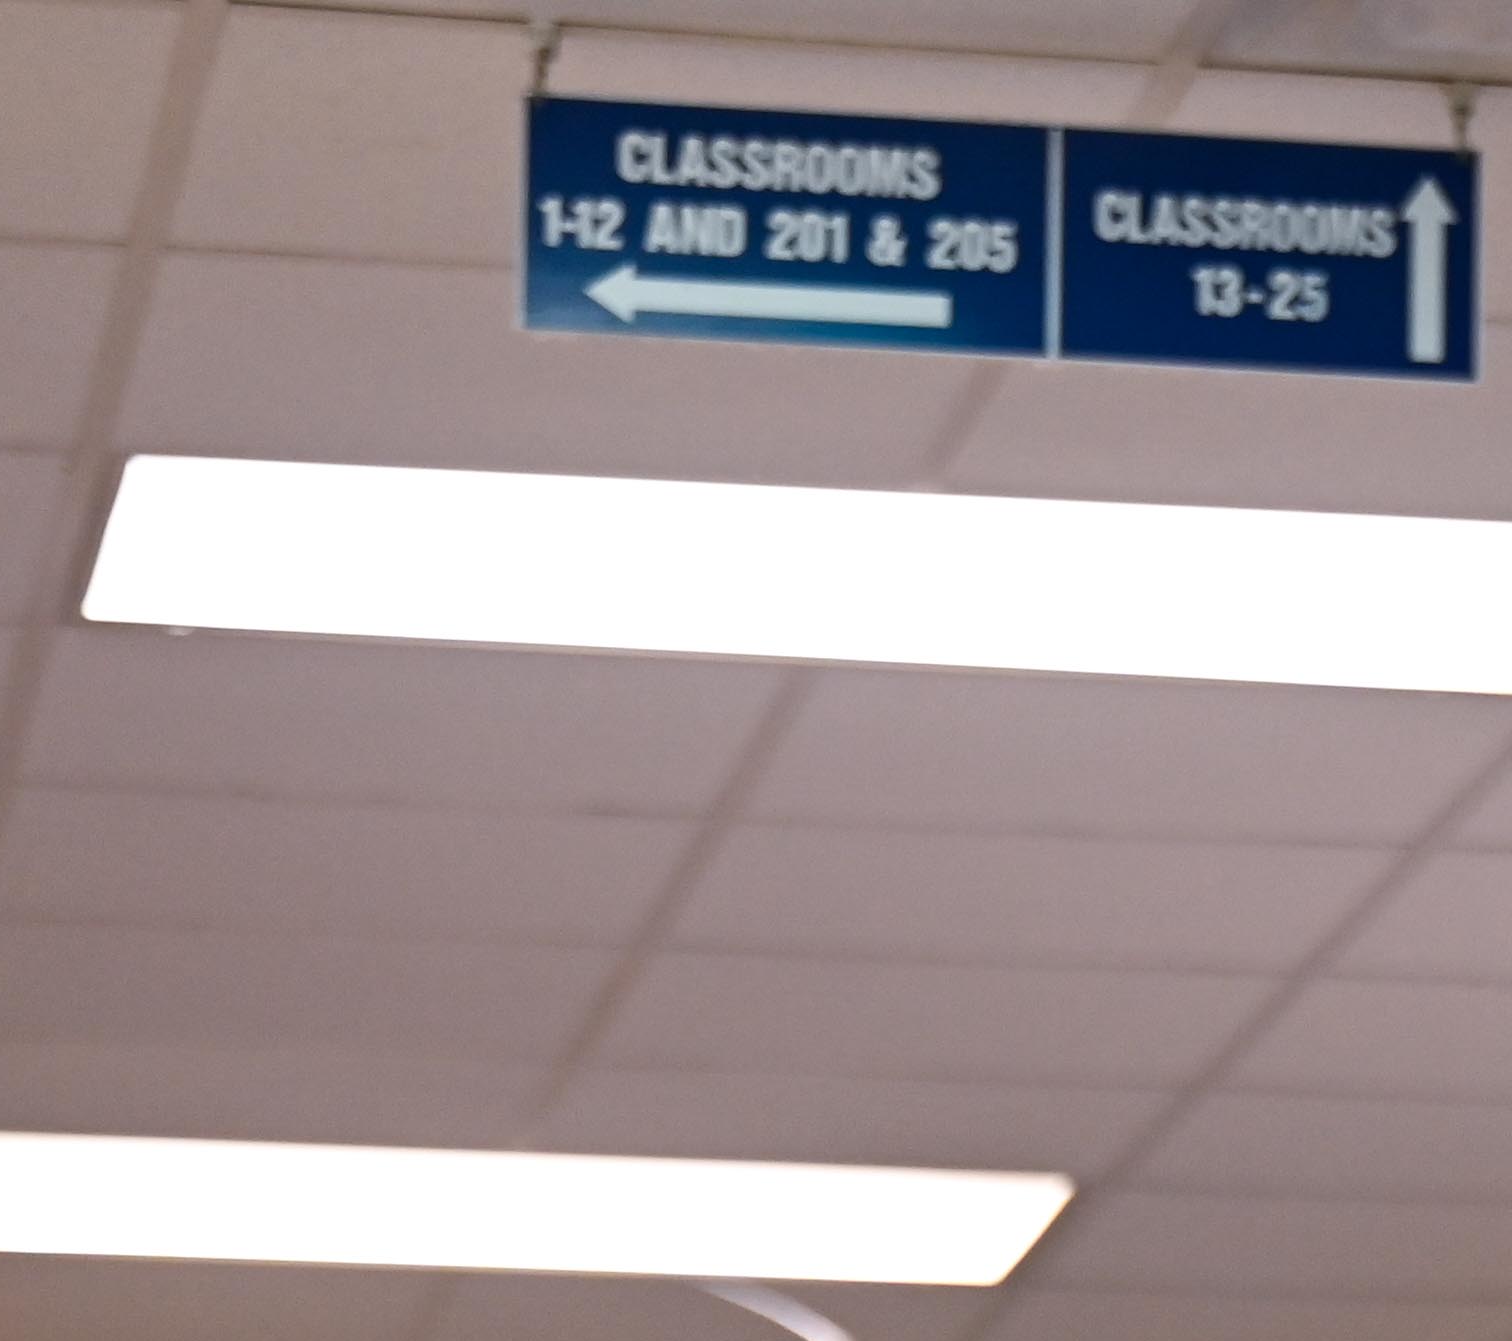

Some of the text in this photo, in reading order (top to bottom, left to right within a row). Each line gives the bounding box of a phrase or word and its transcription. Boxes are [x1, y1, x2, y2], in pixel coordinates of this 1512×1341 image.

[615, 131, 943, 201] CLASSROOMS
[539, 195, 1020, 274] 1-12 AND 201 & 205
[1093, 190, 1396, 259] CLASSROOMS
[1192, 265, 1330, 323] 13-25
